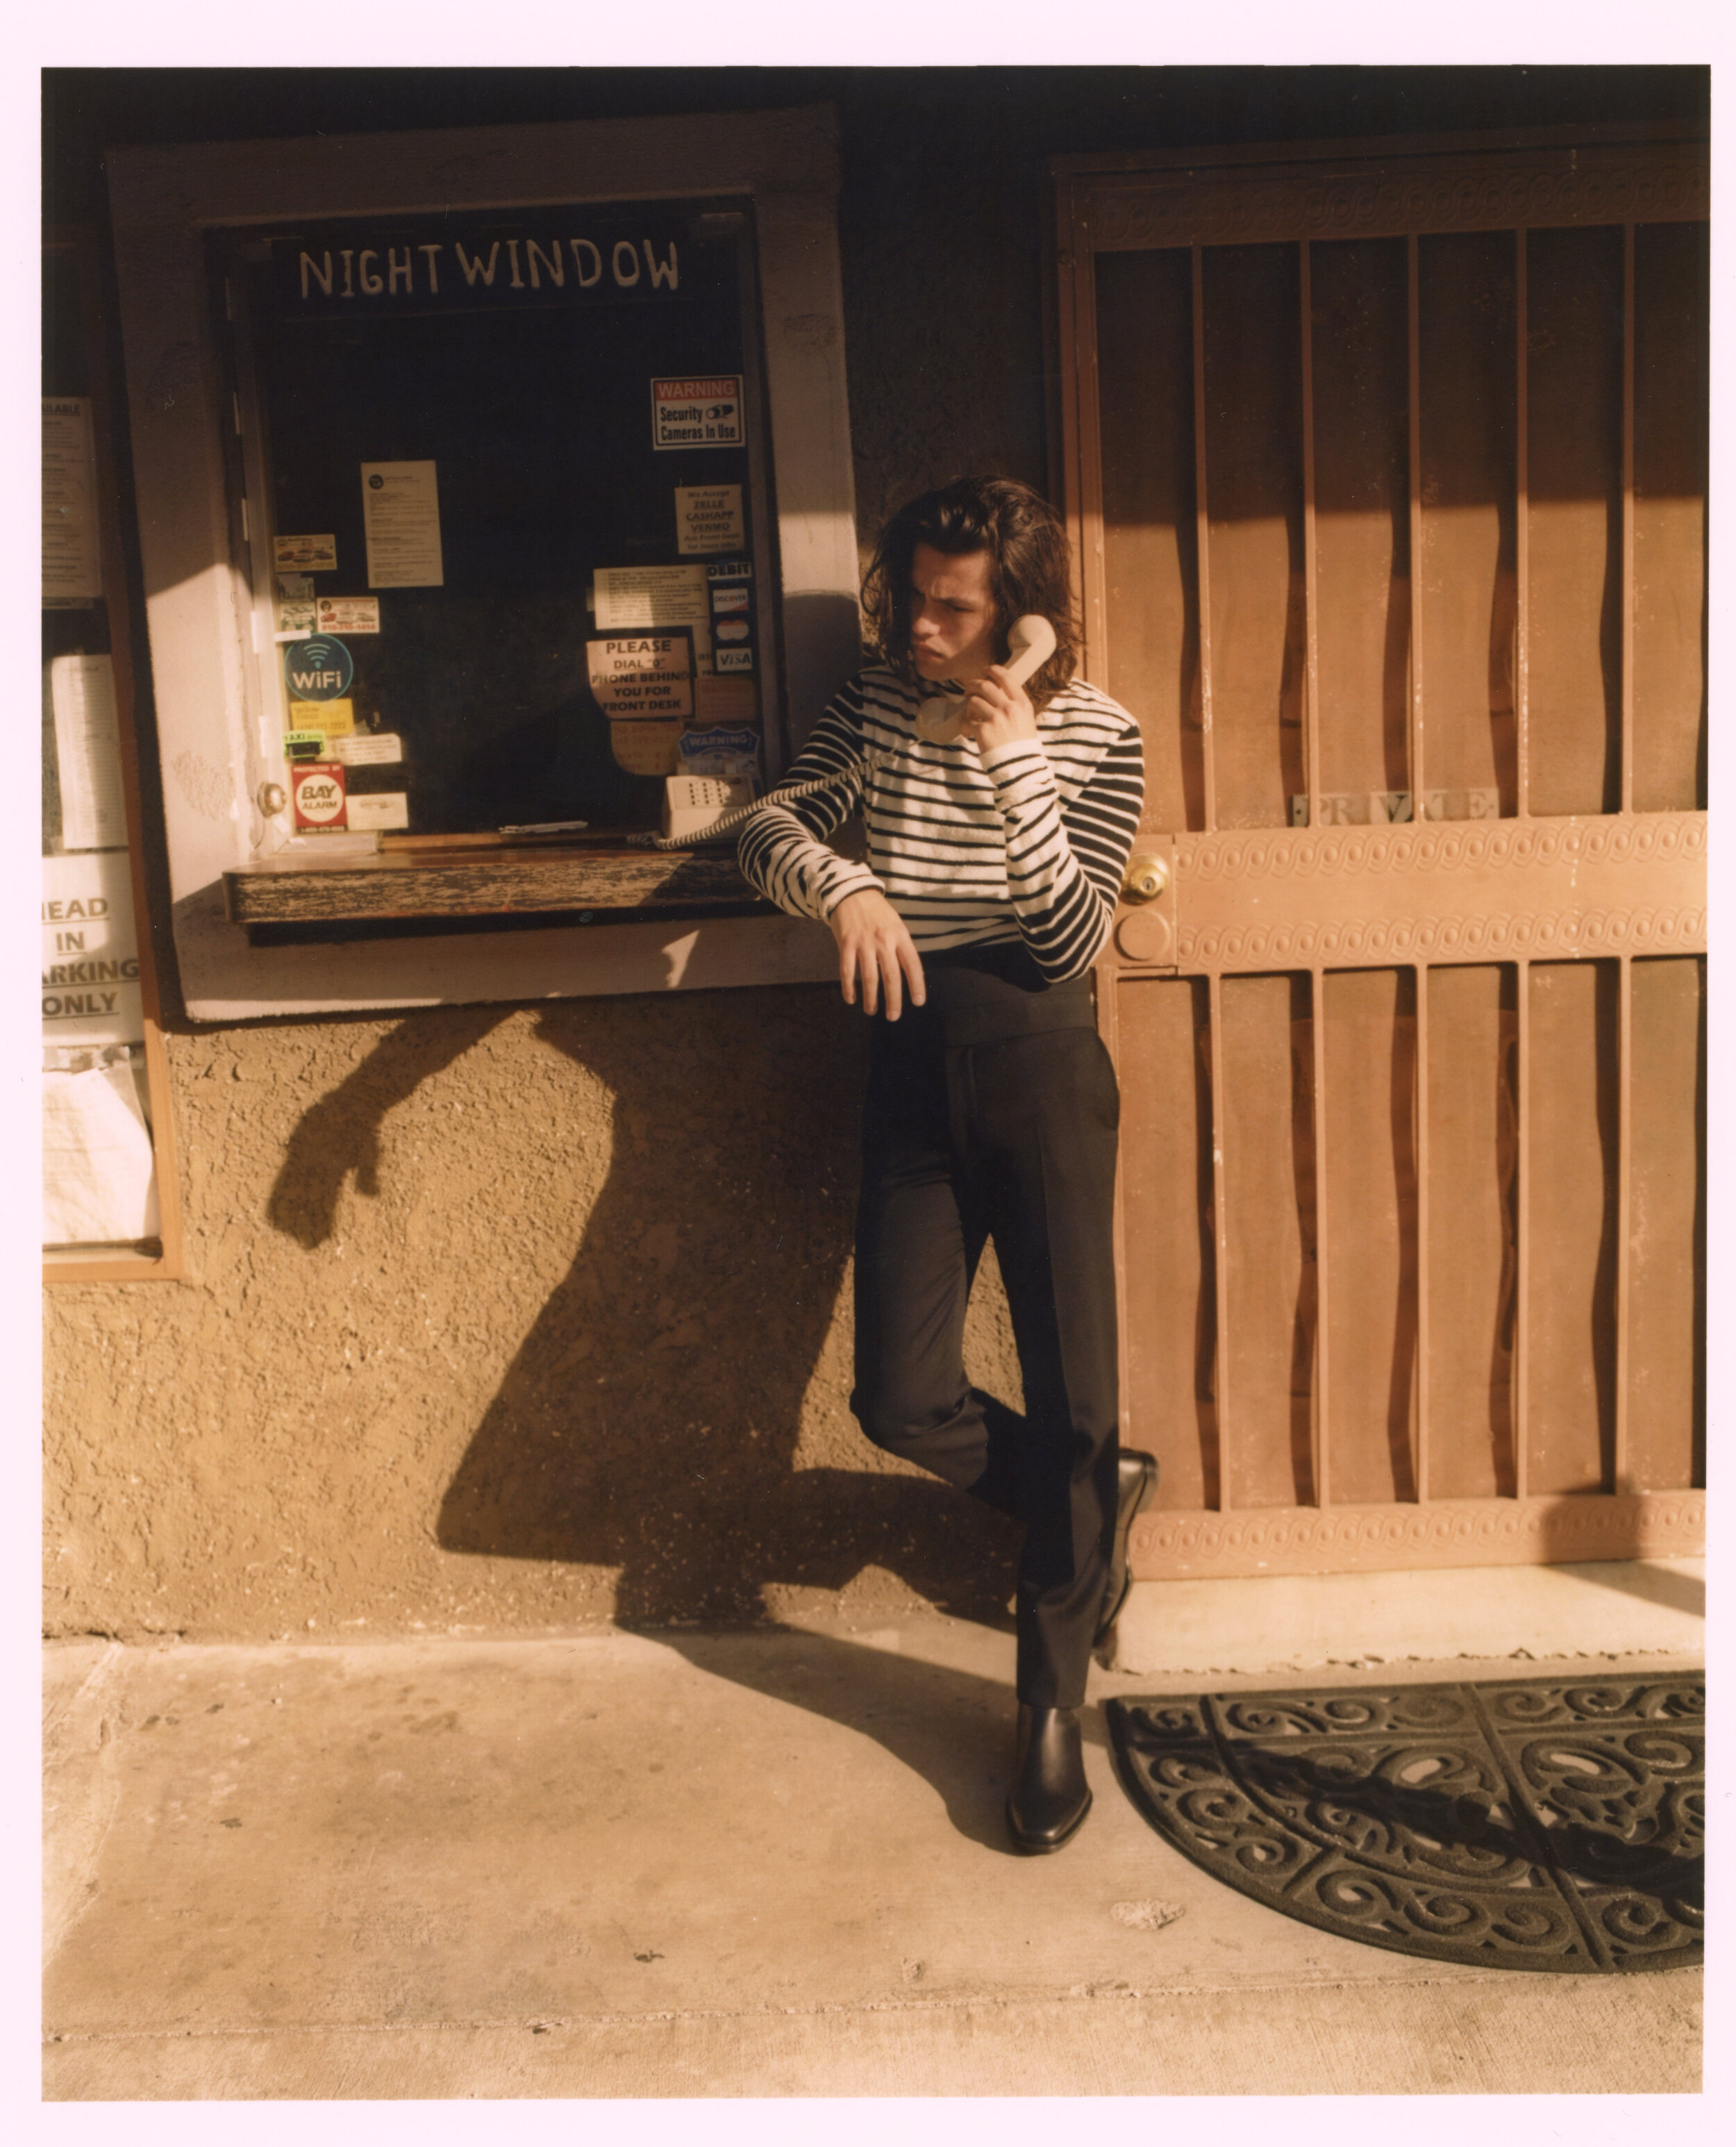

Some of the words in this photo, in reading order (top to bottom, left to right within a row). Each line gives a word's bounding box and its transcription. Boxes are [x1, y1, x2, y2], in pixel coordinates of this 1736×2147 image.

[300, 244, 443, 299] NIGHT
[455, 240, 678, 290] WINDOW
[658, 381, 735, 399] WARNING
[660, 406, 702, 424] Security
[661, 425, 703, 440] Cameras
[706, 424, 715, 438] In
[718, 423, 735, 438] Use
[694, 499, 724, 509] ZELLE
[685, 511, 734, 522] CASHAPP
[691, 522, 730, 533] VENMO
[707, 563, 749, 577] DEBIT
[715, 594, 746, 603] DISCOVER
[606, 639, 671, 654] PLEASE
[614, 659, 644, 669] DIAL
[720, 652, 751, 665] VISA
[292, 671, 342, 689] WiFi
[592, 674, 637, 684] PHONE
[640, 672, 690, 682] BEHIND
[614, 687, 641, 697] YOU
[645, 686, 671, 695] FOR
[603, 701, 646, 711] FRONT
[649, 699, 681, 710] DESK
[688, 735, 747, 747] WARNING
[301, 784, 337, 800] BAY
[301, 801, 337, 810] ALARM
[42, 898, 108, 920] EAD
[56, 931, 85, 951] IN
[42, 991, 117, 1016] ONLY
